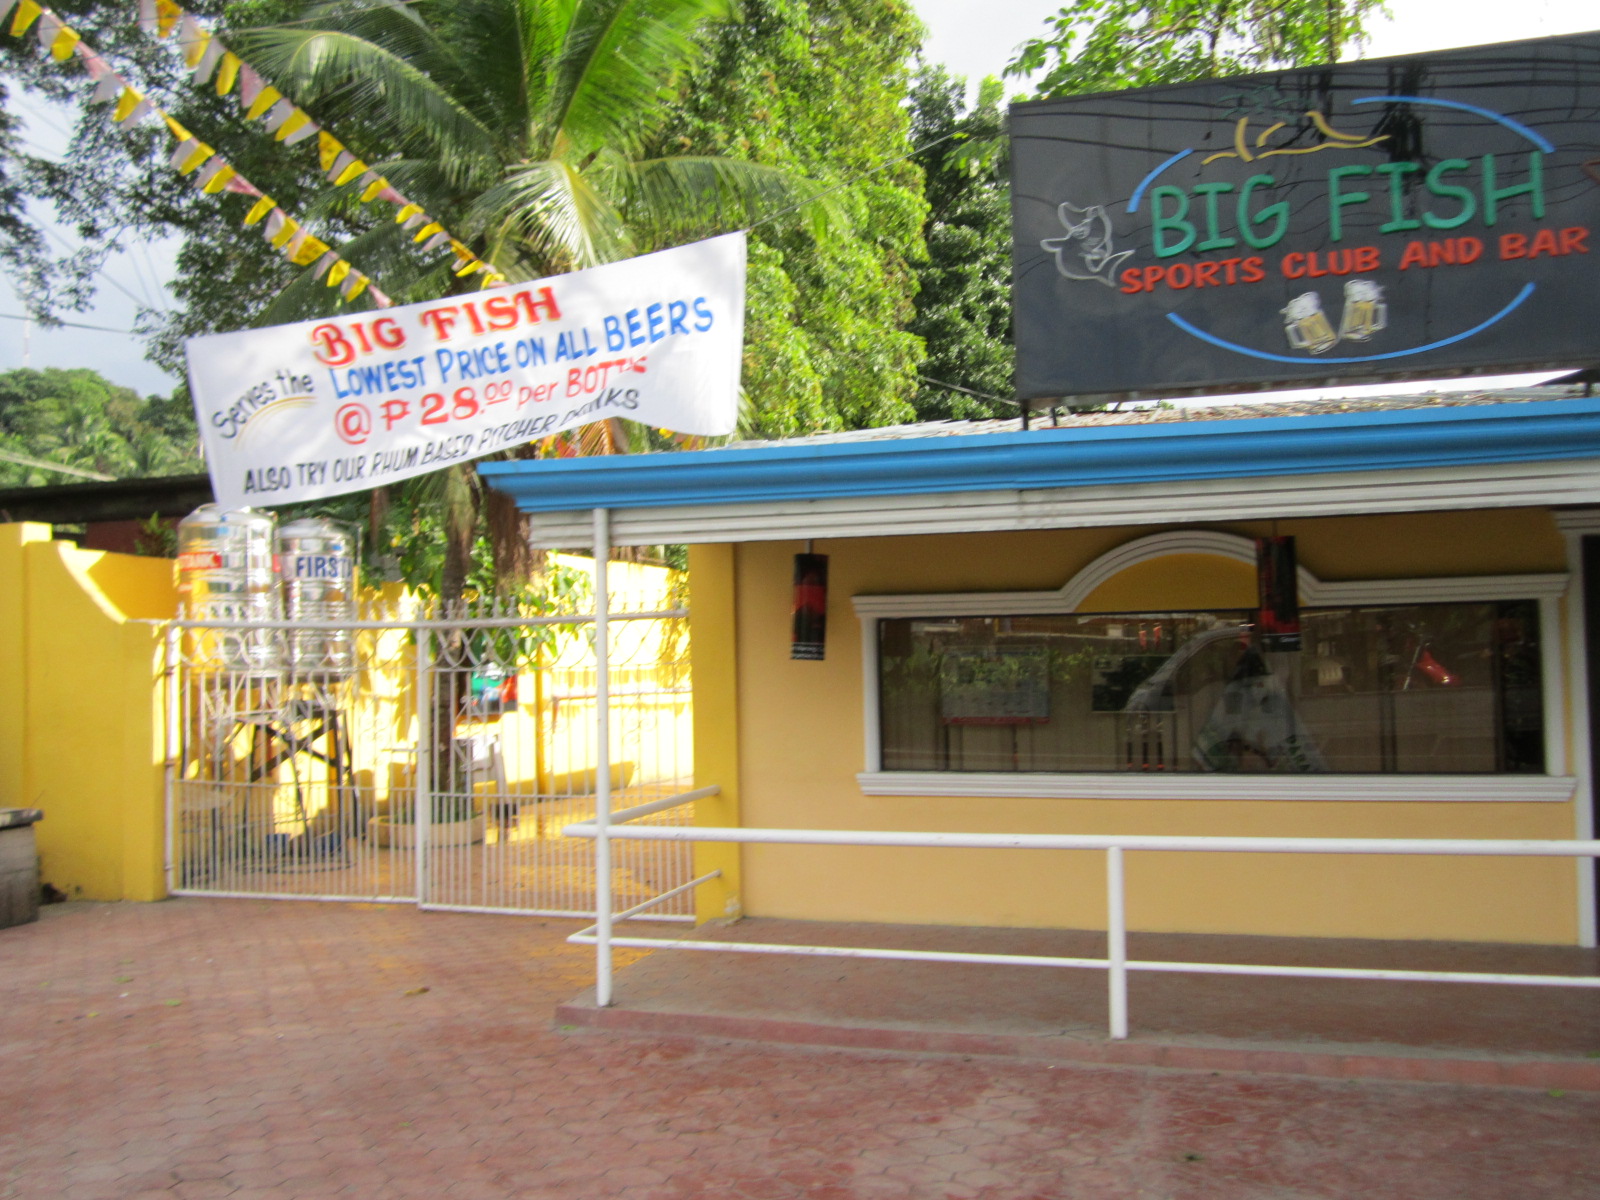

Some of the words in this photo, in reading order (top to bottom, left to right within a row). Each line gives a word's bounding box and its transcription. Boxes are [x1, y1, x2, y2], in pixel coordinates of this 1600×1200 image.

[1150, 173, 1290, 259] BIG
[1328, 150, 1546, 242] FISH
[1119, 255, 1266, 295] SPORTS
[1281, 246, 1380, 279] CLUB
[1400, 236, 1484, 270] AND
[1500, 226, 1590, 261] BAR
[311, 317, 407, 367] BIG
[420, 285, 562, 343] FISH
[329, 355, 426, 399] LOWEST
[435, 341, 512, 384] PRICE
[515, 336, 547, 369] ON
[554, 327, 598, 364] ALL
[603, 297, 714, 353] BEERS
[210, 381, 277, 440] Serves
[275, 368, 314, 396] the
[516, 380, 559, 412] per
[565, 356, 648, 399] BOTT
[244, 465, 292, 495] ALSO
[296, 460, 327, 489] TRY
[332, 453, 367, 483] OUR
[478, 413, 559, 450] PITCHER
